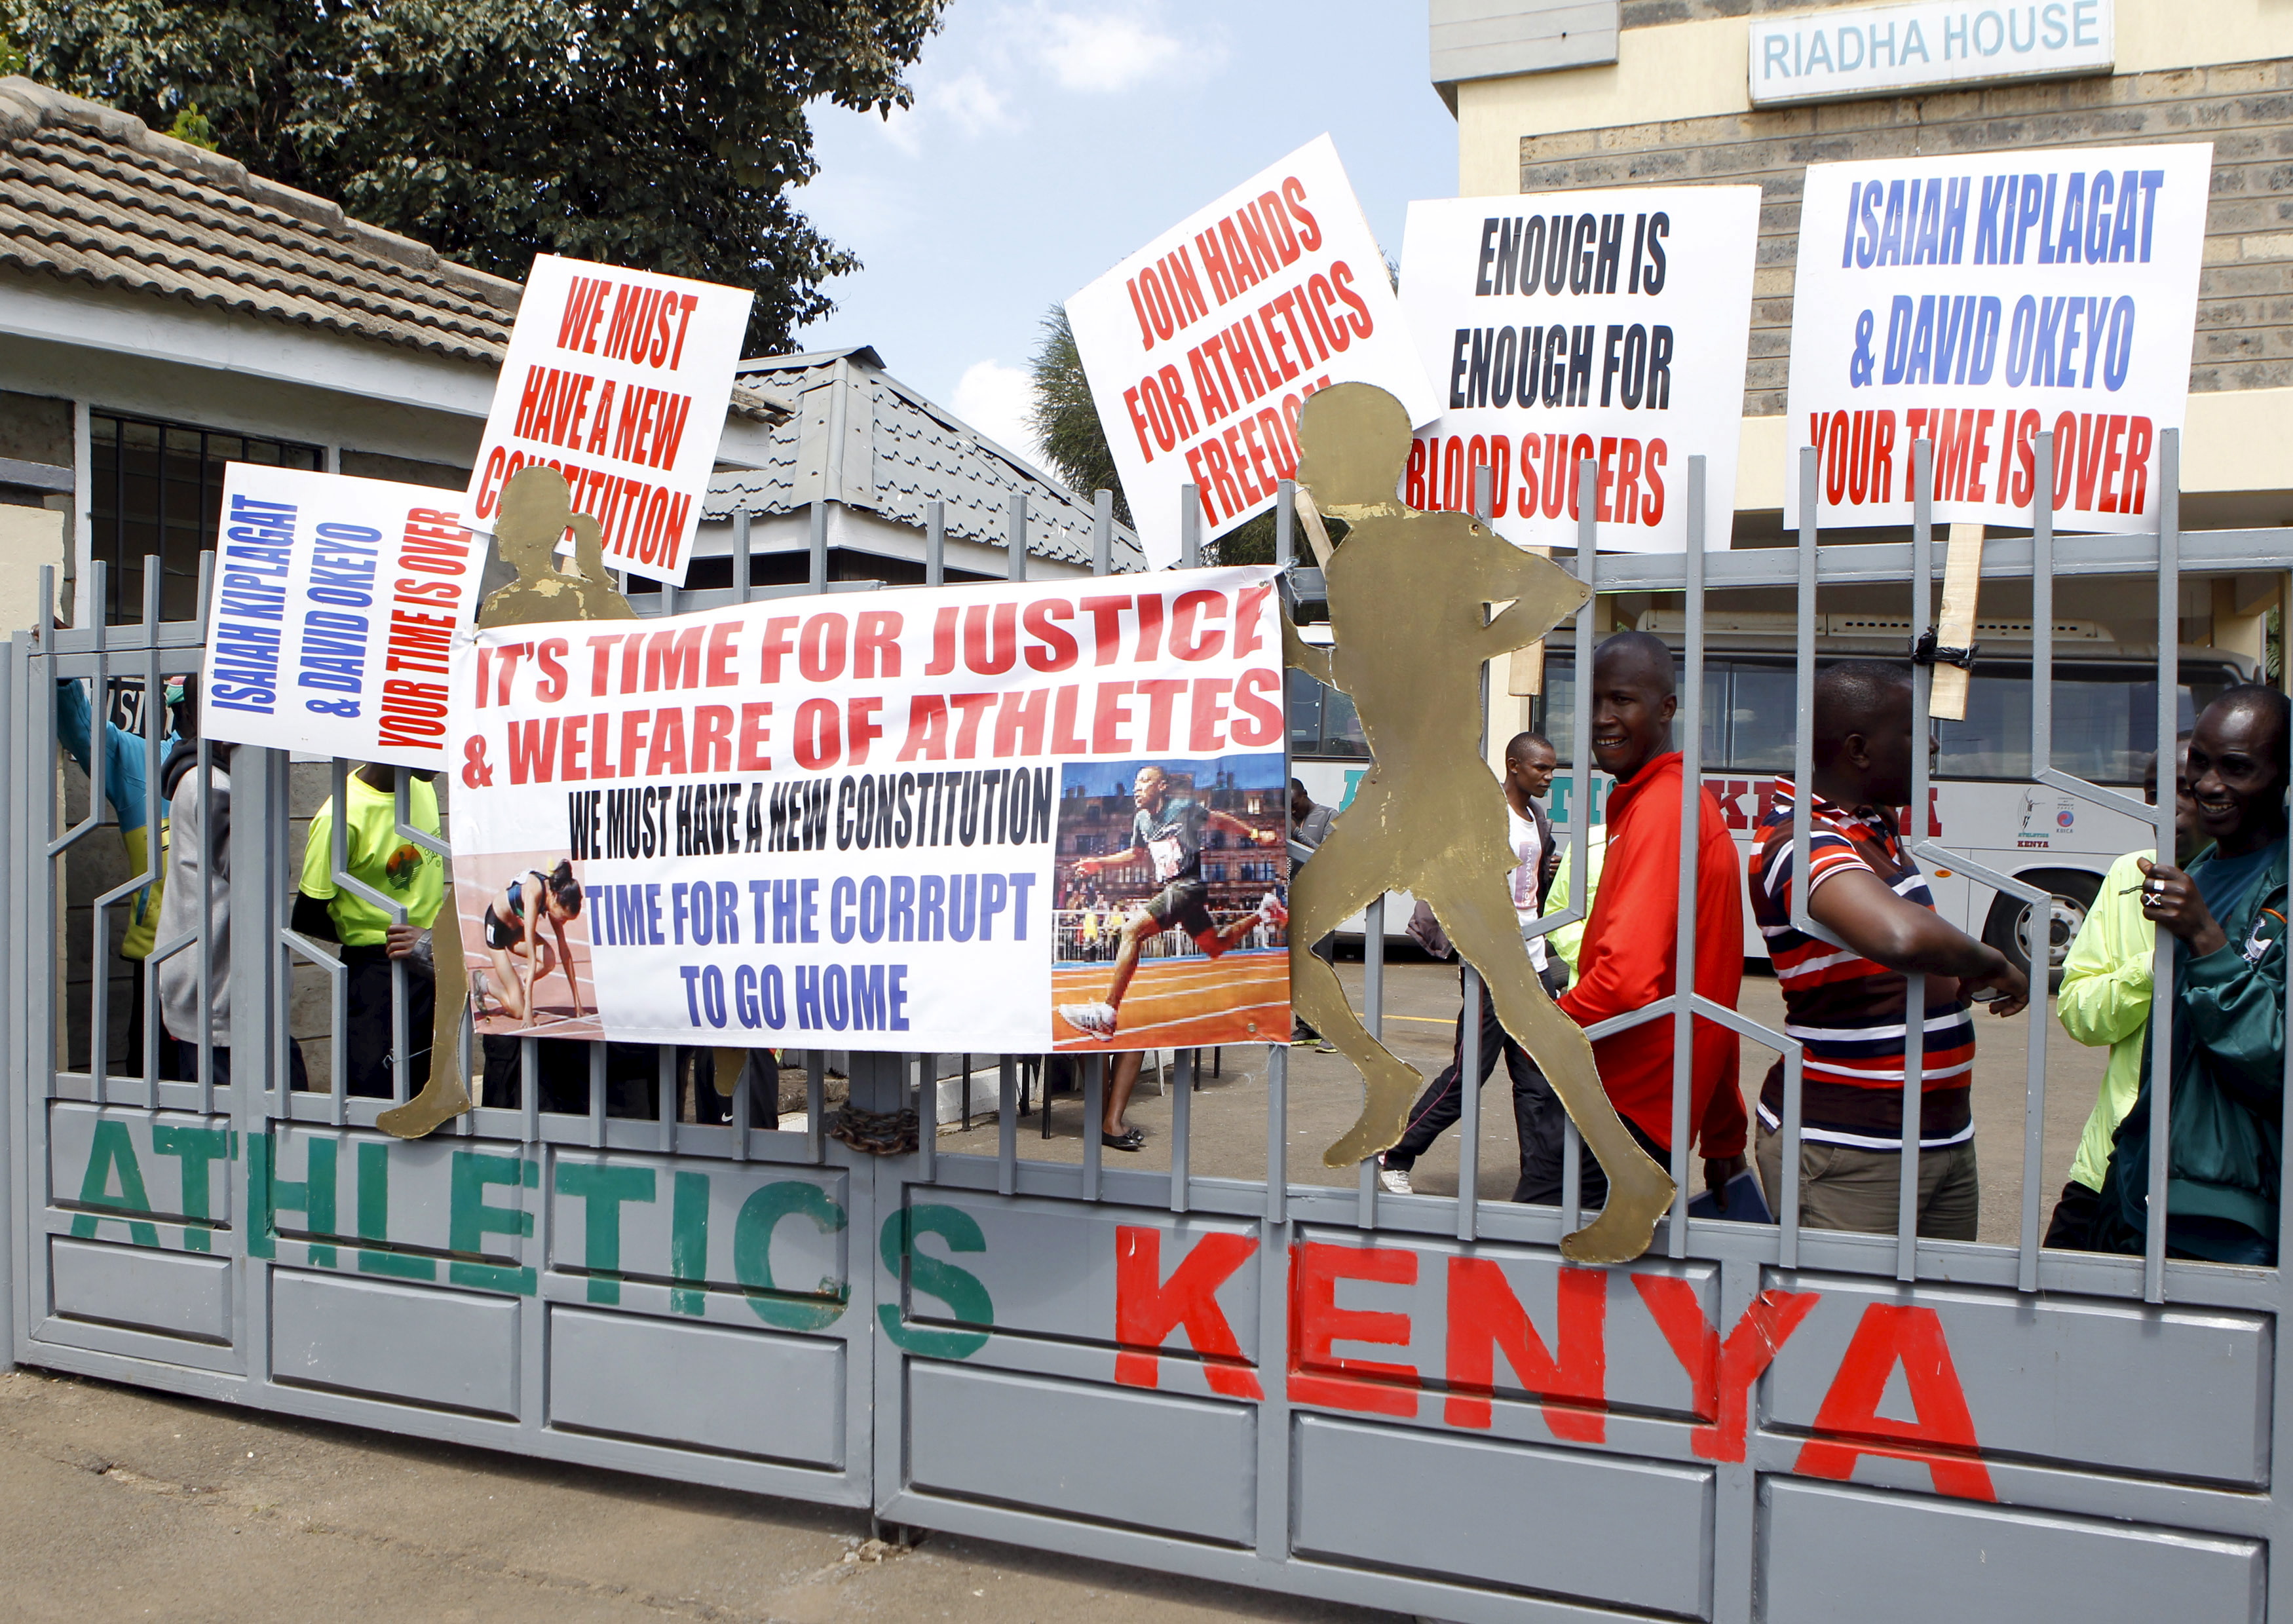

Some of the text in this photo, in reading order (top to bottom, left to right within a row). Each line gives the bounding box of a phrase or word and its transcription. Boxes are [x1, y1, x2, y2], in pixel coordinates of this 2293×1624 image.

[1763, 0, 2099, 79] RIADHA HOUSE
[1126, 176, 1322, 352] JOIN HANDS
[1475, 212, 1669, 296] ENOUGH IS
[1842, 170, 2164, 269] ISAIAH KIPLAGAT
[557, 276, 698, 371] WE MUST
[1123, 261, 1374, 464] FOR ATHLETICS
[1449, 324, 1673, 410] ENOUGH FOR
[1849, 294, 2135, 392] & DAVID OKEYO
[514, 365, 692, 471] HAVE A NEW
[1184, 375, 1331, 528] FREEDO
[1996, 409, 2042, 508] IS
[2052, 410, 2153, 515] OVER
[1406, 434, 1510, 518] BLOOD
[211, 495, 297, 715] ISAIAH KIPLAGAT
[298, 523, 382, 718] & DAVID OKEYO
[378, 508, 473, 749] YOUR TIME IS OVER
[475, 587, 1272, 709] IT'S TIME FOR JUSTICE
[462, 668, 1284, 789] & WELFARE OF ATHLETES
[568, 767, 1053, 861] WE MUST HAVE A NEW CONSTITUTION
[584, 873, 1036, 946] TIME FOR THE CORRUPT
[1523, 847, 1532, 907] MARATHON
[680, 964, 909, 1031] TO GO HOME
[71, 1120, 1998, 1503] ATHLETICS KENYA
